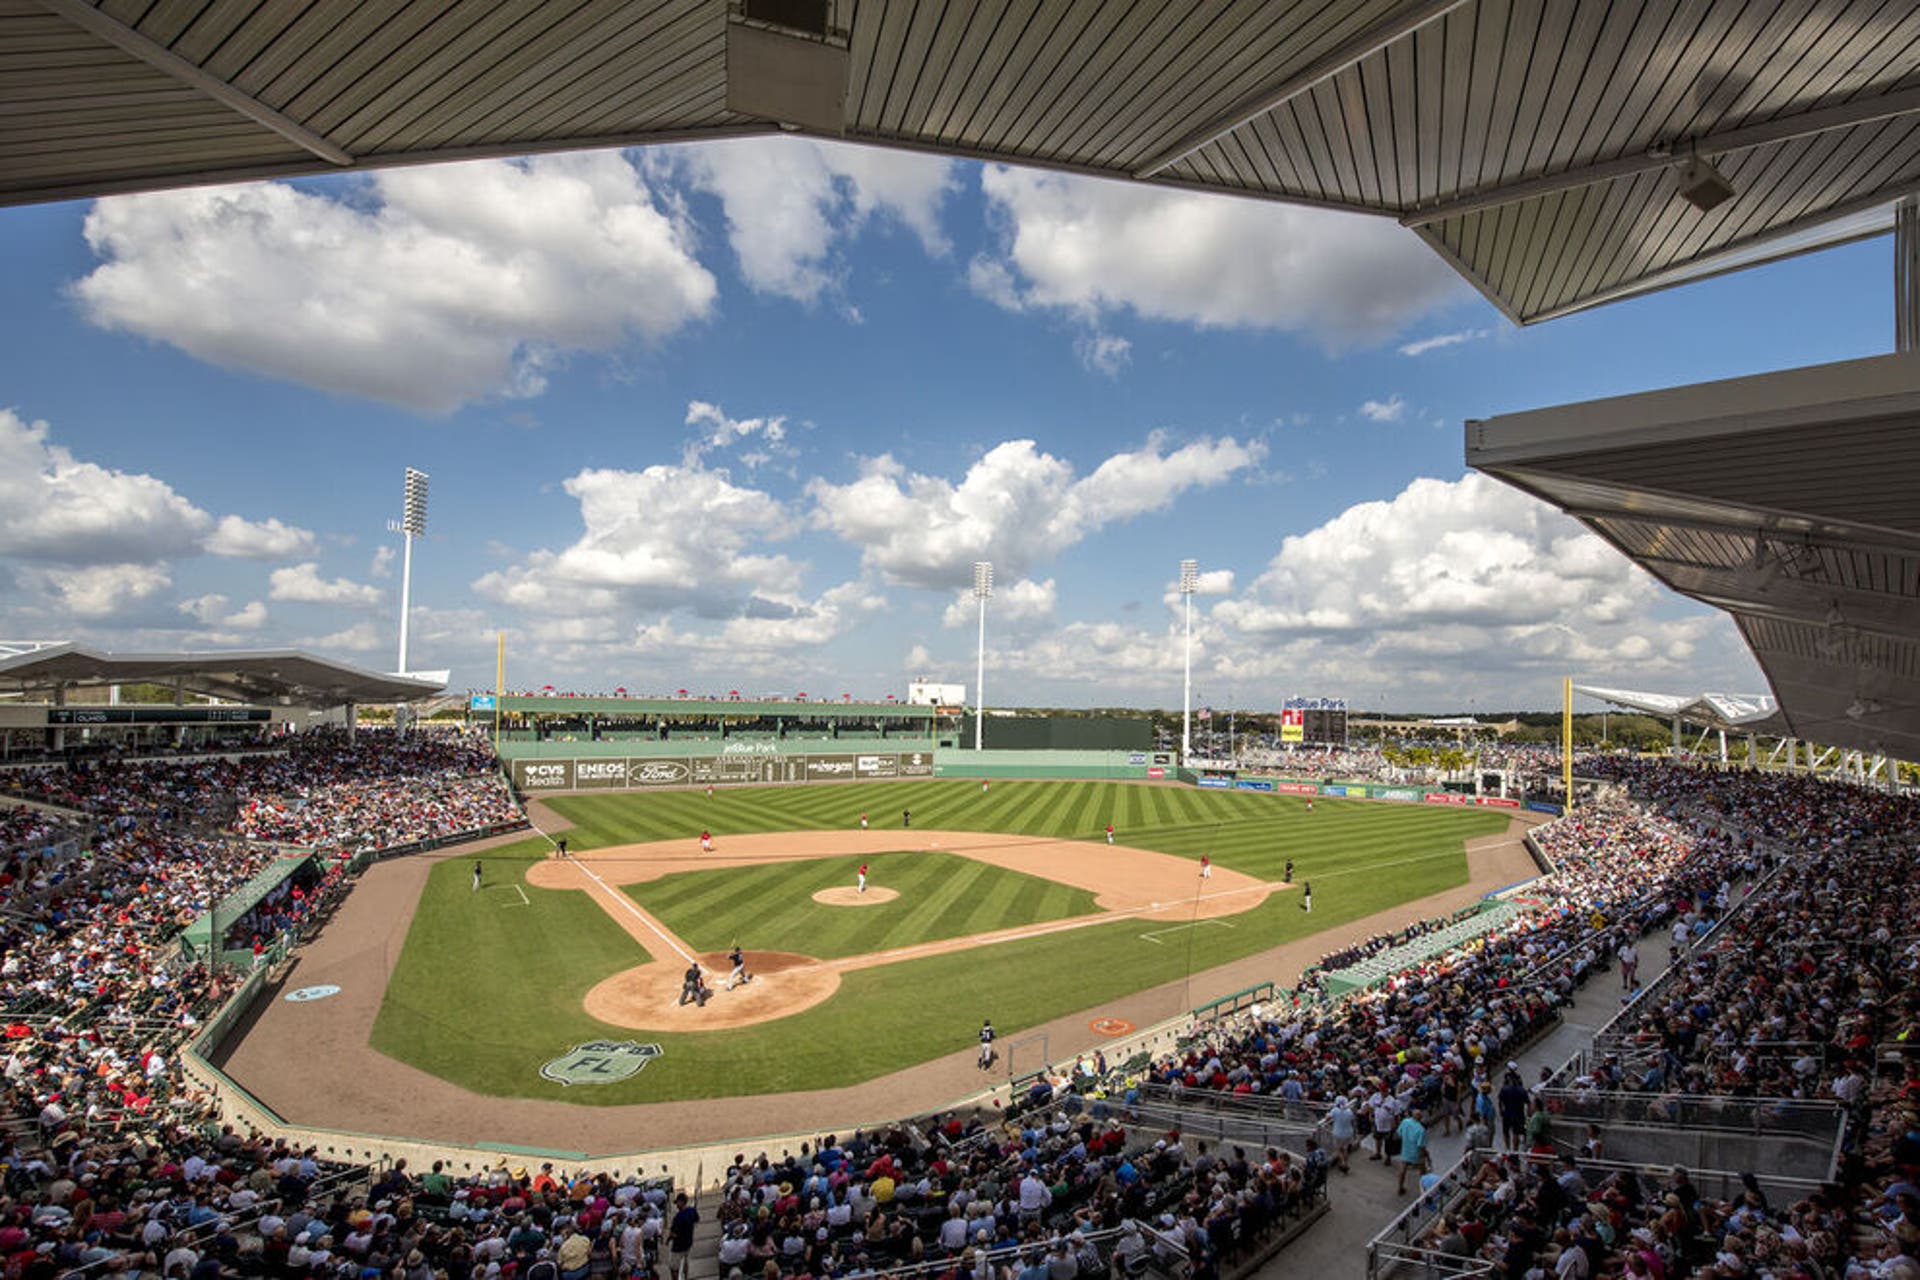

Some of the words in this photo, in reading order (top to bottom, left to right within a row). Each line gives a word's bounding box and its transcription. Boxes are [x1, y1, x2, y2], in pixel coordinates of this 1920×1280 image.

[1320, 697, 1346, 709] Park
[756, 742, 777, 753] Park
[538, 765, 565, 775] CVS
[640, 763, 679, 780] Ford
[526, 776, 565, 787] Health
[567, 1056, 613, 1074] FL
